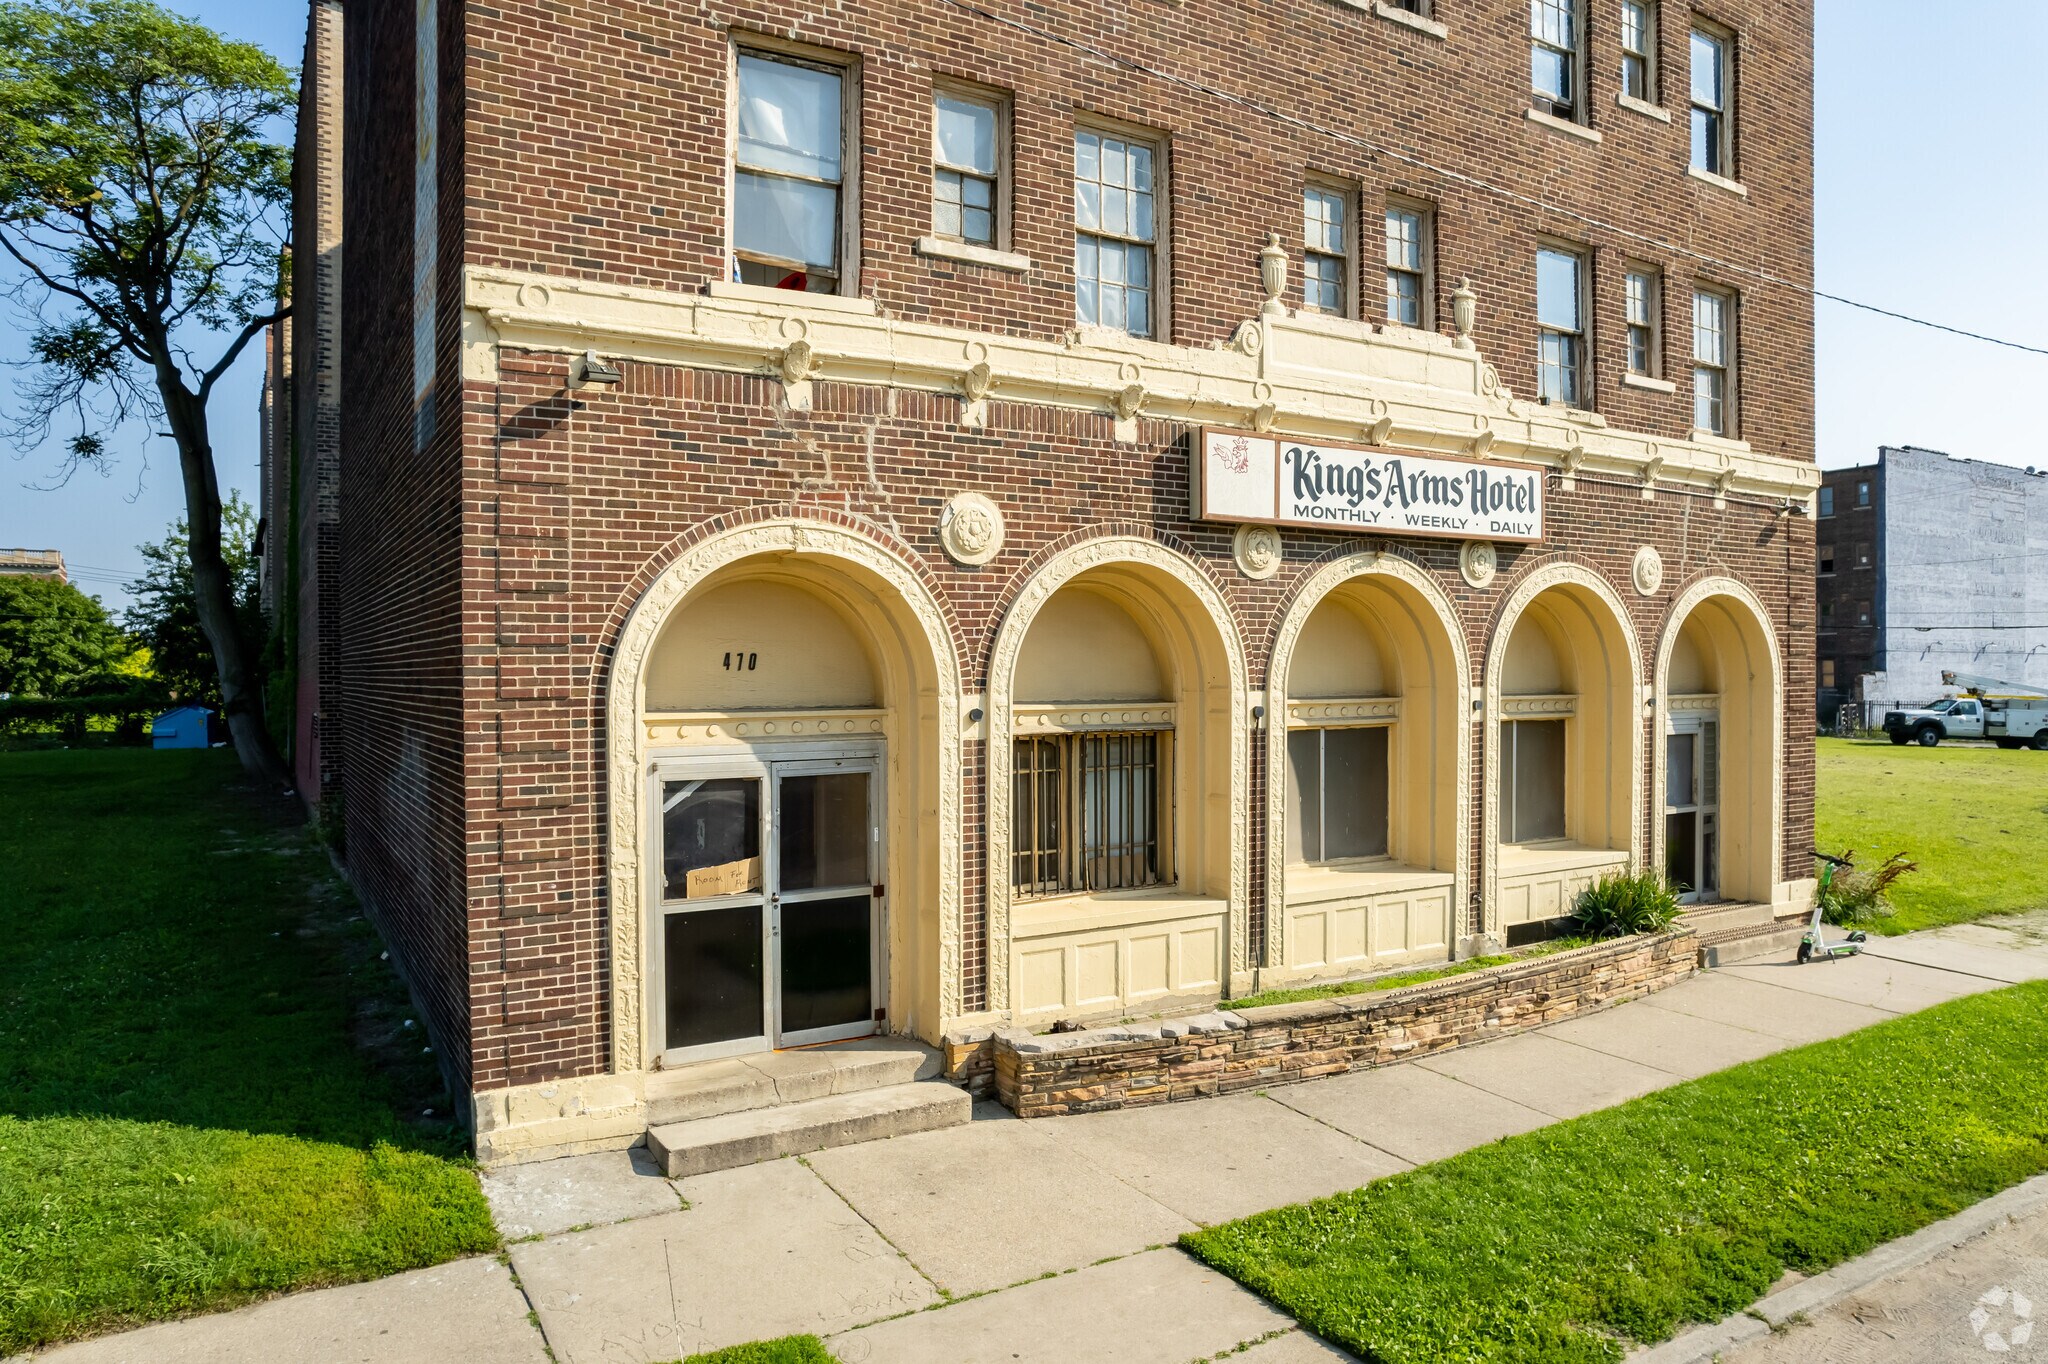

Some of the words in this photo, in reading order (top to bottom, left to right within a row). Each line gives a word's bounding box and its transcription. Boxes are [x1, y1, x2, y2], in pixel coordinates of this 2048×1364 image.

[1284, 447, 1382, 508] King's
[1383, 459, 1464, 510] Arms
[1465, 468, 1536, 516] Hotel
[1294, 504, 1381, 523] MONTHLY
[1405, 514, 1468, 530] WEEKLY
[1490, 521, 1533, 535] DAILY
[694, 874, 723, 886] ROOM
